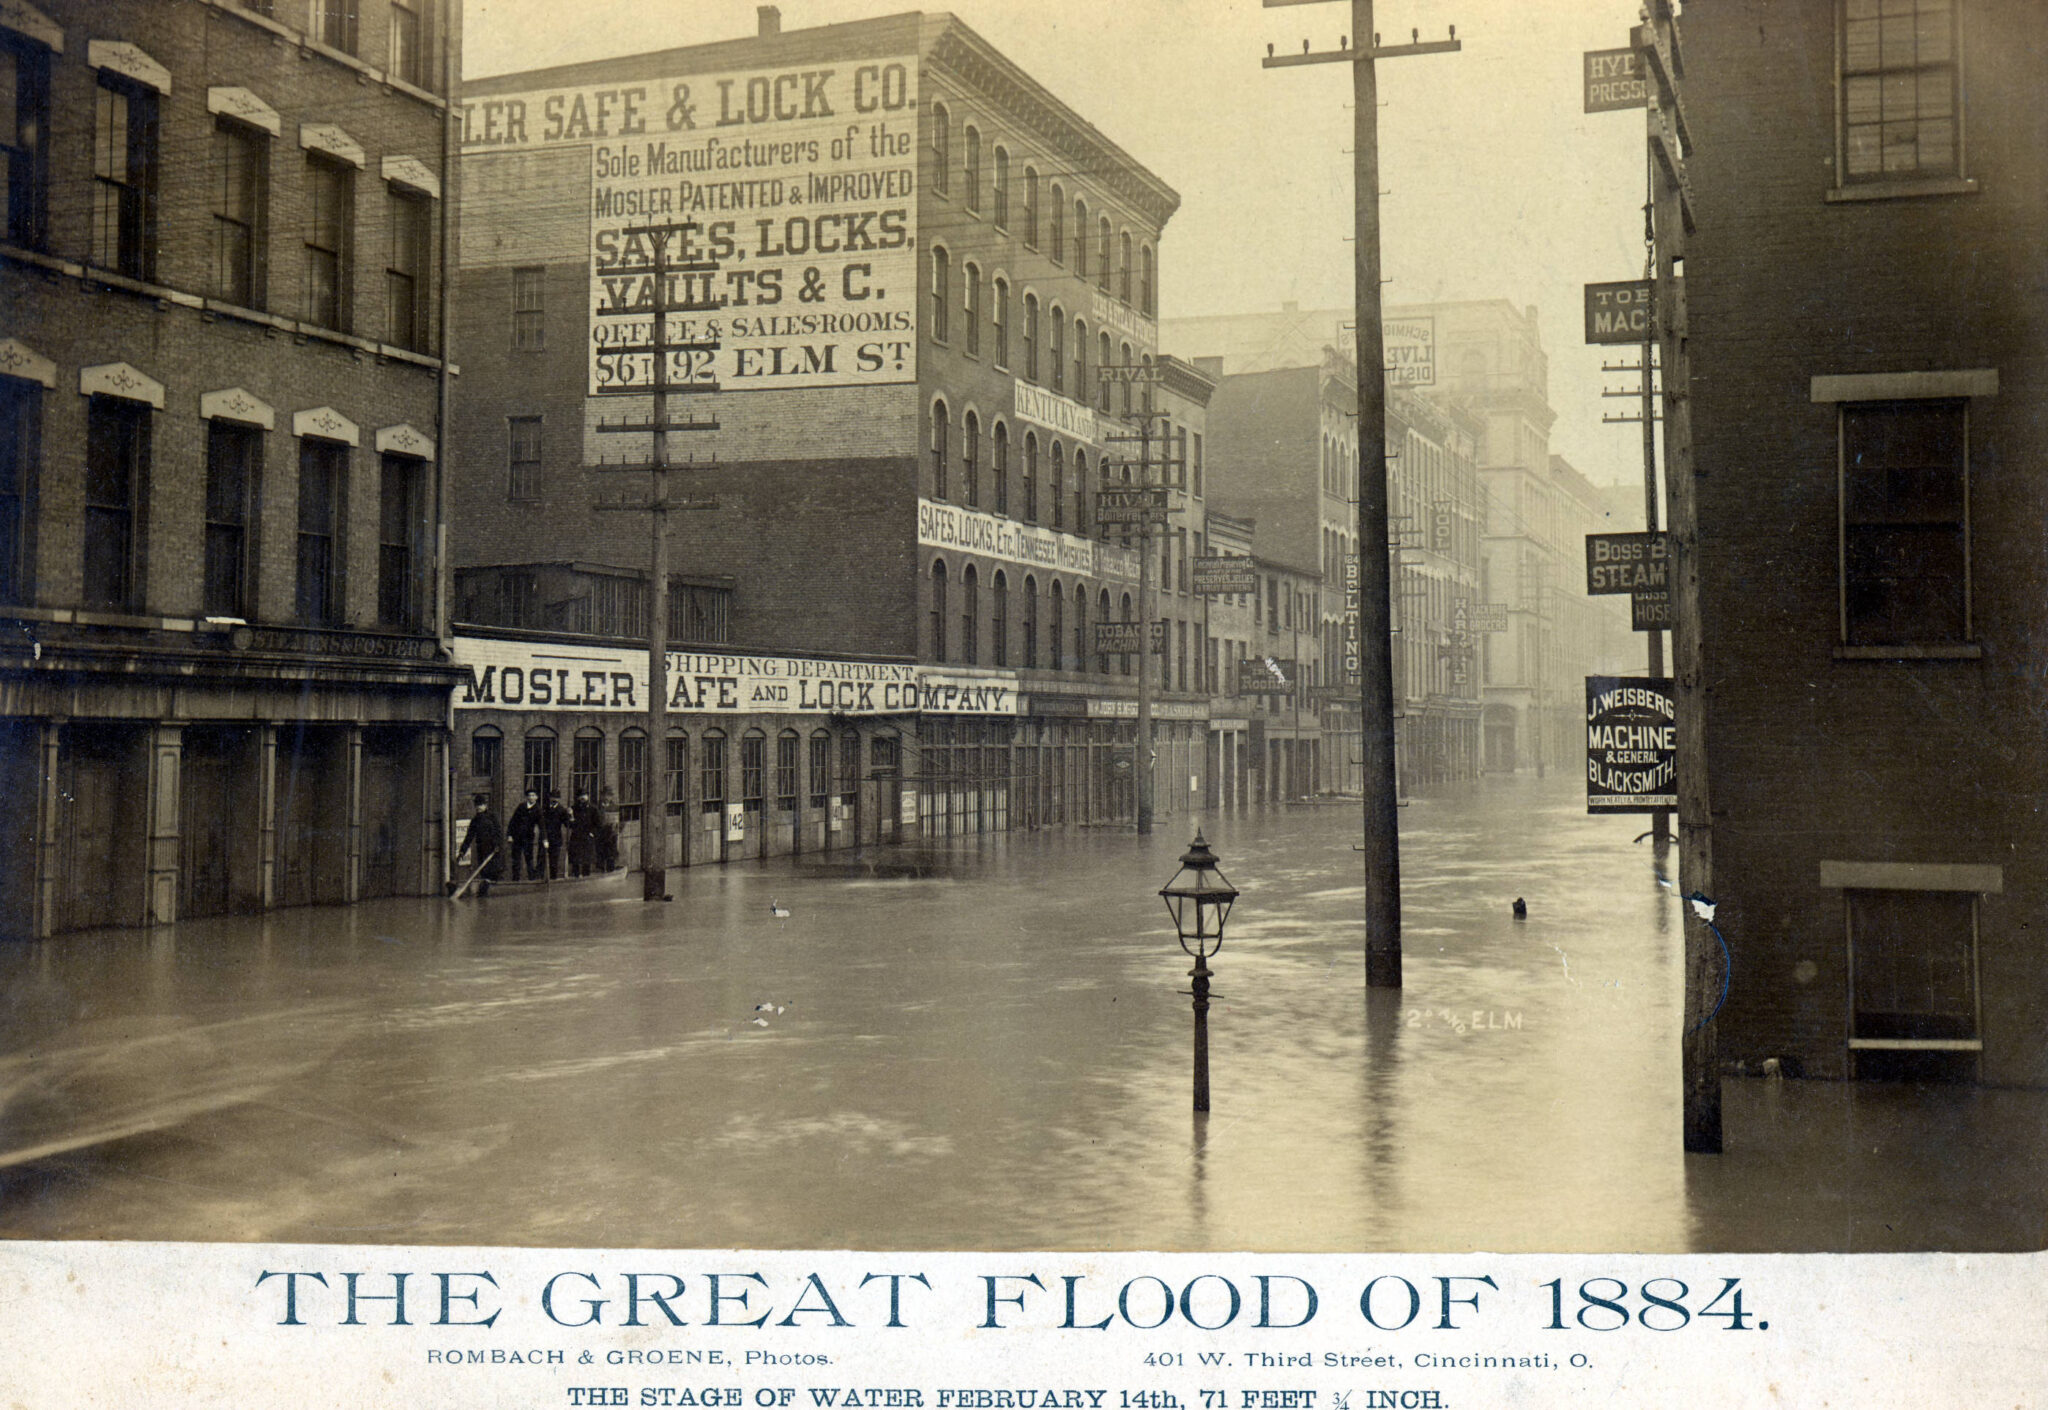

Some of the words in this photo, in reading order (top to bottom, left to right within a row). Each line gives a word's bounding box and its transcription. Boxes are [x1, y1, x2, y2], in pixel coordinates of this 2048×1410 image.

[544, 86, 646, 142] SAFE
[666, 83, 696, 131] &
[715, 69, 836, 127] LOCK
[854, 63, 917, 114] CO.
[596, 146, 640, 178] Sole
[646, 137, 819, 175] Manufacturers
[831, 126, 859, 161] of
[870, 122, 910, 157] the
[595, 186, 672, 218] MOSLER
[680, 179, 783, 213] PATENTED
[789, 186, 803, 205] &
[808, 169, 913, 205] IMPROVED
[595, 221, 746, 267] SAES,
[755, 209, 915, 259] LOCKS,
[601, 269, 783, 311] VAULTS
[799, 265, 826, 303] &
[842, 263, 886, 302] C.
[705, 319, 722, 341] &
[596, 354, 635, 383] 86
[672, 350, 715, 380] 92
[732, 344, 839, 377] ELM
[1099, 367, 1164, 382] RIVAL
[1016, 384, 1077, 433] KENTUCKY
[1076, 415, 1091, 439] AND
[920, 505, 958, 545] SAFES,
[959, 513, 995, 552] LOCKS,
[1015, 527, 1056, 566] TENNESSEE
[1056, 535, 1090, 571] WHISKIES
[1592, 563, 1665, 588] STEAM
[1345, 564, 1359, 670] BELTING
[462, 664, 636, 707] MOSLER
[668, 676, 738, 708] AFE
[751, 685, 788, 702] AND
[799, 680, 875, 711] LOCK
[884, 681, 1010, 713] COMPANY.
[664, 652, 777, 676] SHIPPING
[787, 661, 918, 681] DEPARTMENT.
[1588, 697, 1603, 721] J.
[1600, 688, 1675, 720] WEISBERG
[1588, 725, 1677, 750] MACHINE
[1605, 750, 1617, 764] &
[1617, 751, 1660, 764] GENERAL
[728, 813, 743, 832] 142
